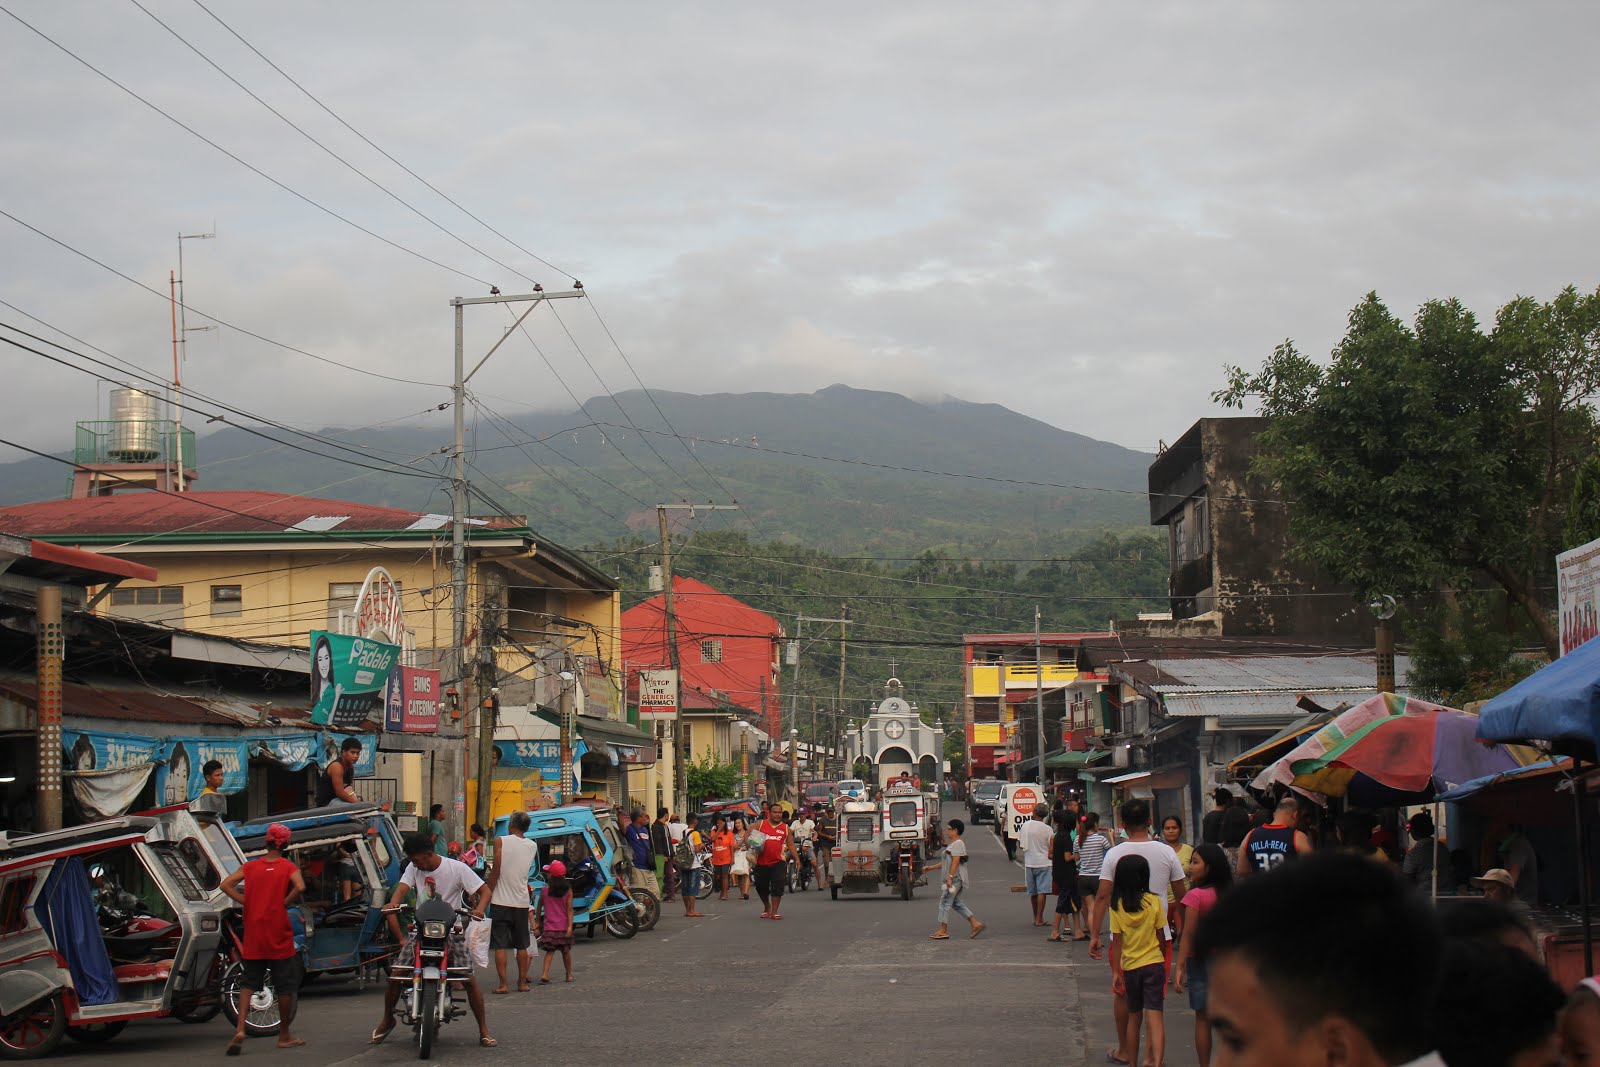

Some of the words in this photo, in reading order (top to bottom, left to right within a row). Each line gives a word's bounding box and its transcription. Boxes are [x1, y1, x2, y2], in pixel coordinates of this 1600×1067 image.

[348, 638, 391, 671] Padala
[408, 699, 436, 716] CATERING
[106, 743, 125, 769] 3X
[515, 742, 540, 758] 3X
[1250, 840, 1288, 853] VILLA-REAL
